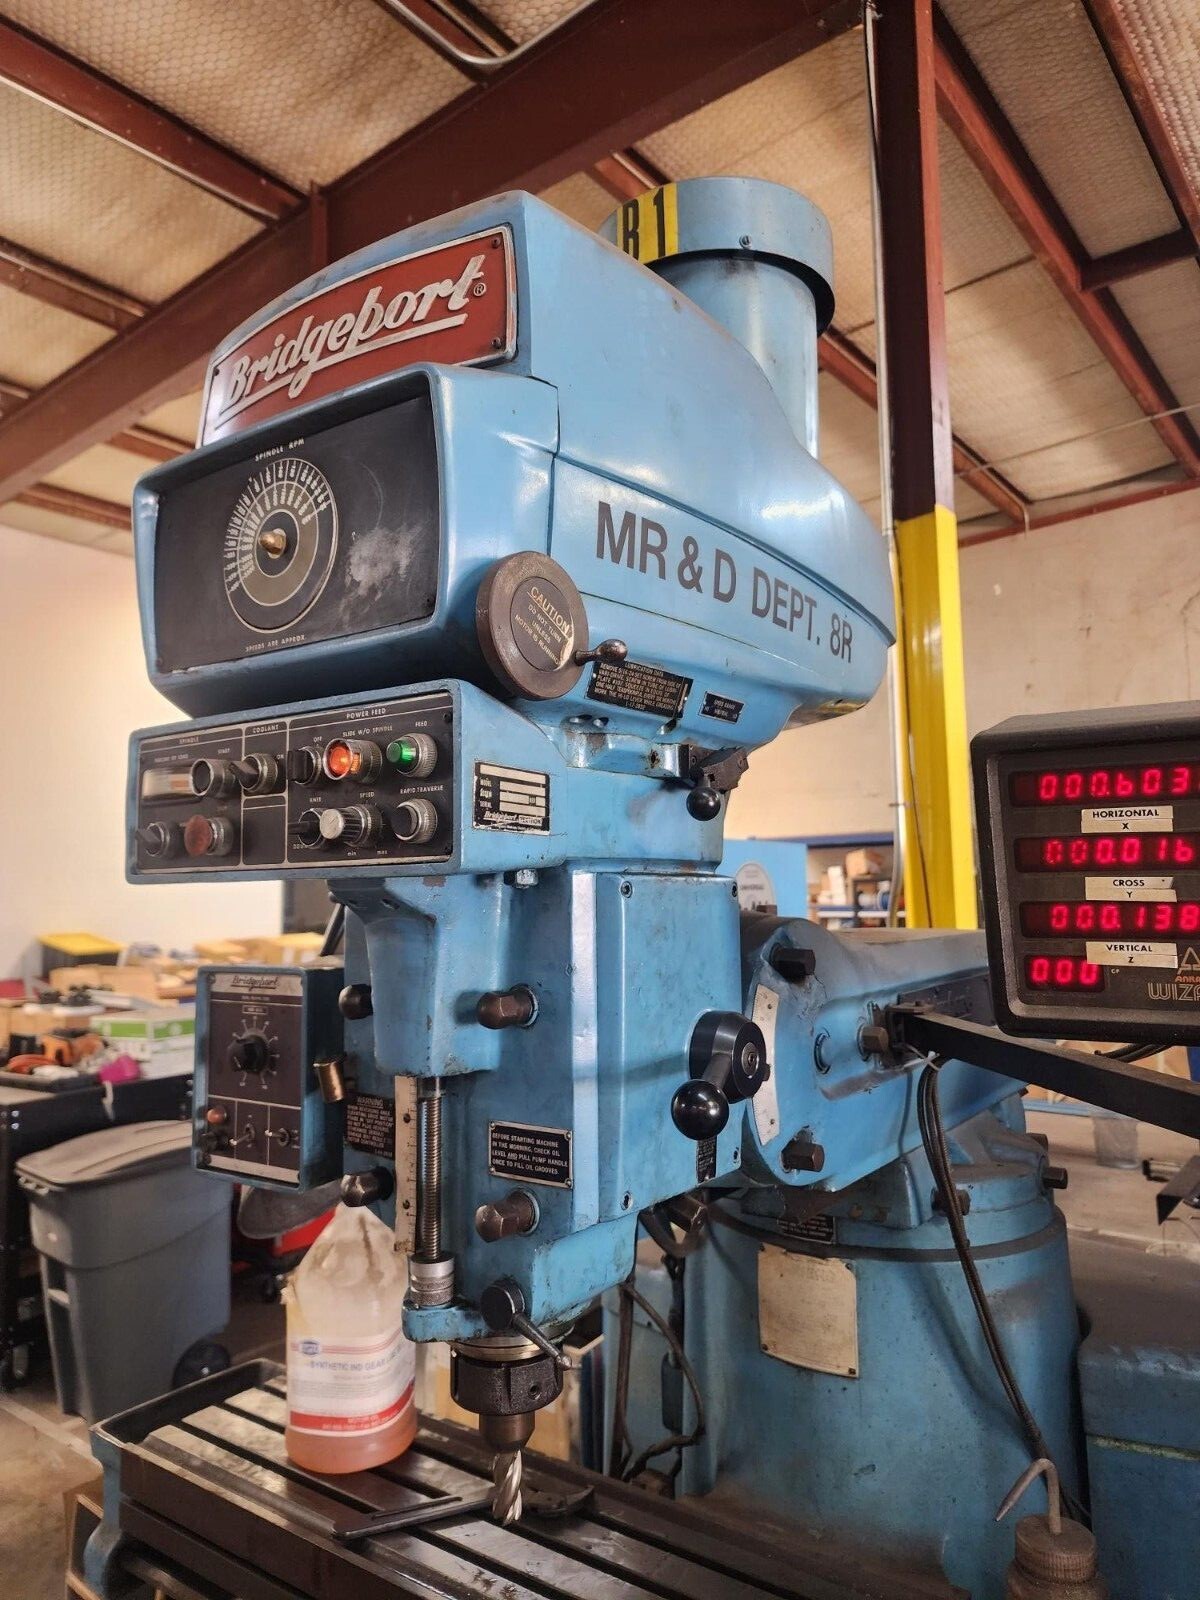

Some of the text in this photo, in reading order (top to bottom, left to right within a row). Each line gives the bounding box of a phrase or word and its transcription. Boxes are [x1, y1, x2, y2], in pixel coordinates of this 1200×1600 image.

[217, 255, 487, 418] Bridgeport
[255, 438, 304, 461] SPINDLE RPM
[528, 604, 537, 615] DO
[537, 613, 548, 627] NOT
[531, 586, 570, 634] CAUTION
[751, 566, 821, 645] DEPT.
[829, 612, 853, 664] 8R
[515, 614, 534, 636] MOTOR
[346, 707, 386, 719] POWER FEED
[252, 724, 279, 734] COOLANT
[400, 784, 444, 794] RAPID TRAVERSE
[359, 791, 375, 799] SPEED
[1092, 808, 1160, 819] HORIZONTAL
[1122, 822, 1130, 830] X
[1112, 879, 1145, 887] CROSS
[1126, 891, 1133, 899] Y
[1106, 944, 1153, 952] VERTICAL
[1128, 956, 1134, 964] Z
[492, 1132, 559, 1148] BEFORE STARTING MACHINE
[533, 1147, 551, 1155] CHECK
[492, 1158, 505, 1166] ONCE
[514, 1162, 524, 1170] FILL
[507, 1152, 518, 1160] AND
[532, 1156, 547, 1164] PUMP
[547, 1159, 568, 1168] HANDLE
